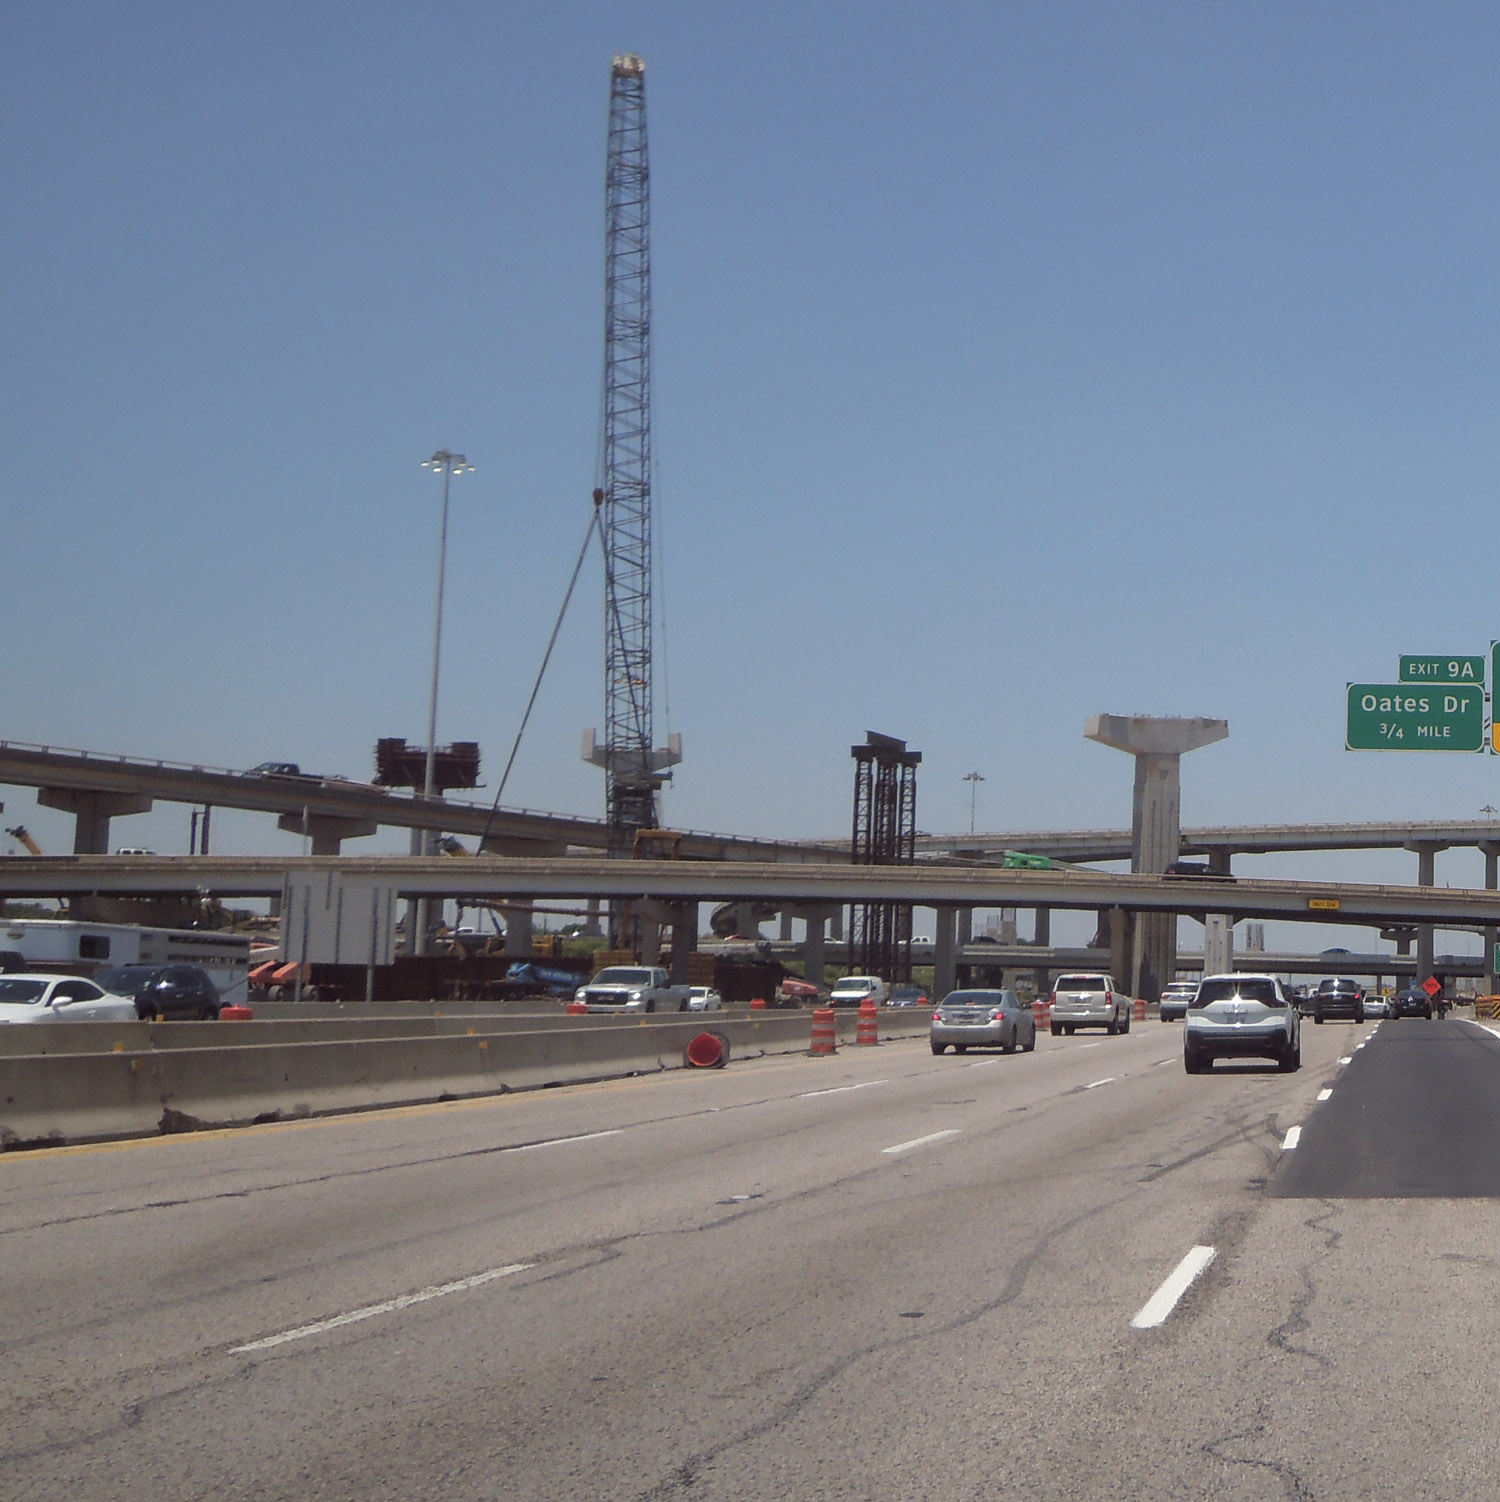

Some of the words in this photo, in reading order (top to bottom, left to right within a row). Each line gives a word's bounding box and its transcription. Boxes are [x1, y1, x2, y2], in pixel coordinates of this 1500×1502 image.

[1408, 663, 1440, 675] EXIT
[1448, 661, 1474, 678] 9A
[1361, 695, 1430, 713] Oates
[1443, 696, 1470, 713] Dr
[1379, 723, 1405, 740] 3/4
[1417, 726, 1451, 737] MILE
